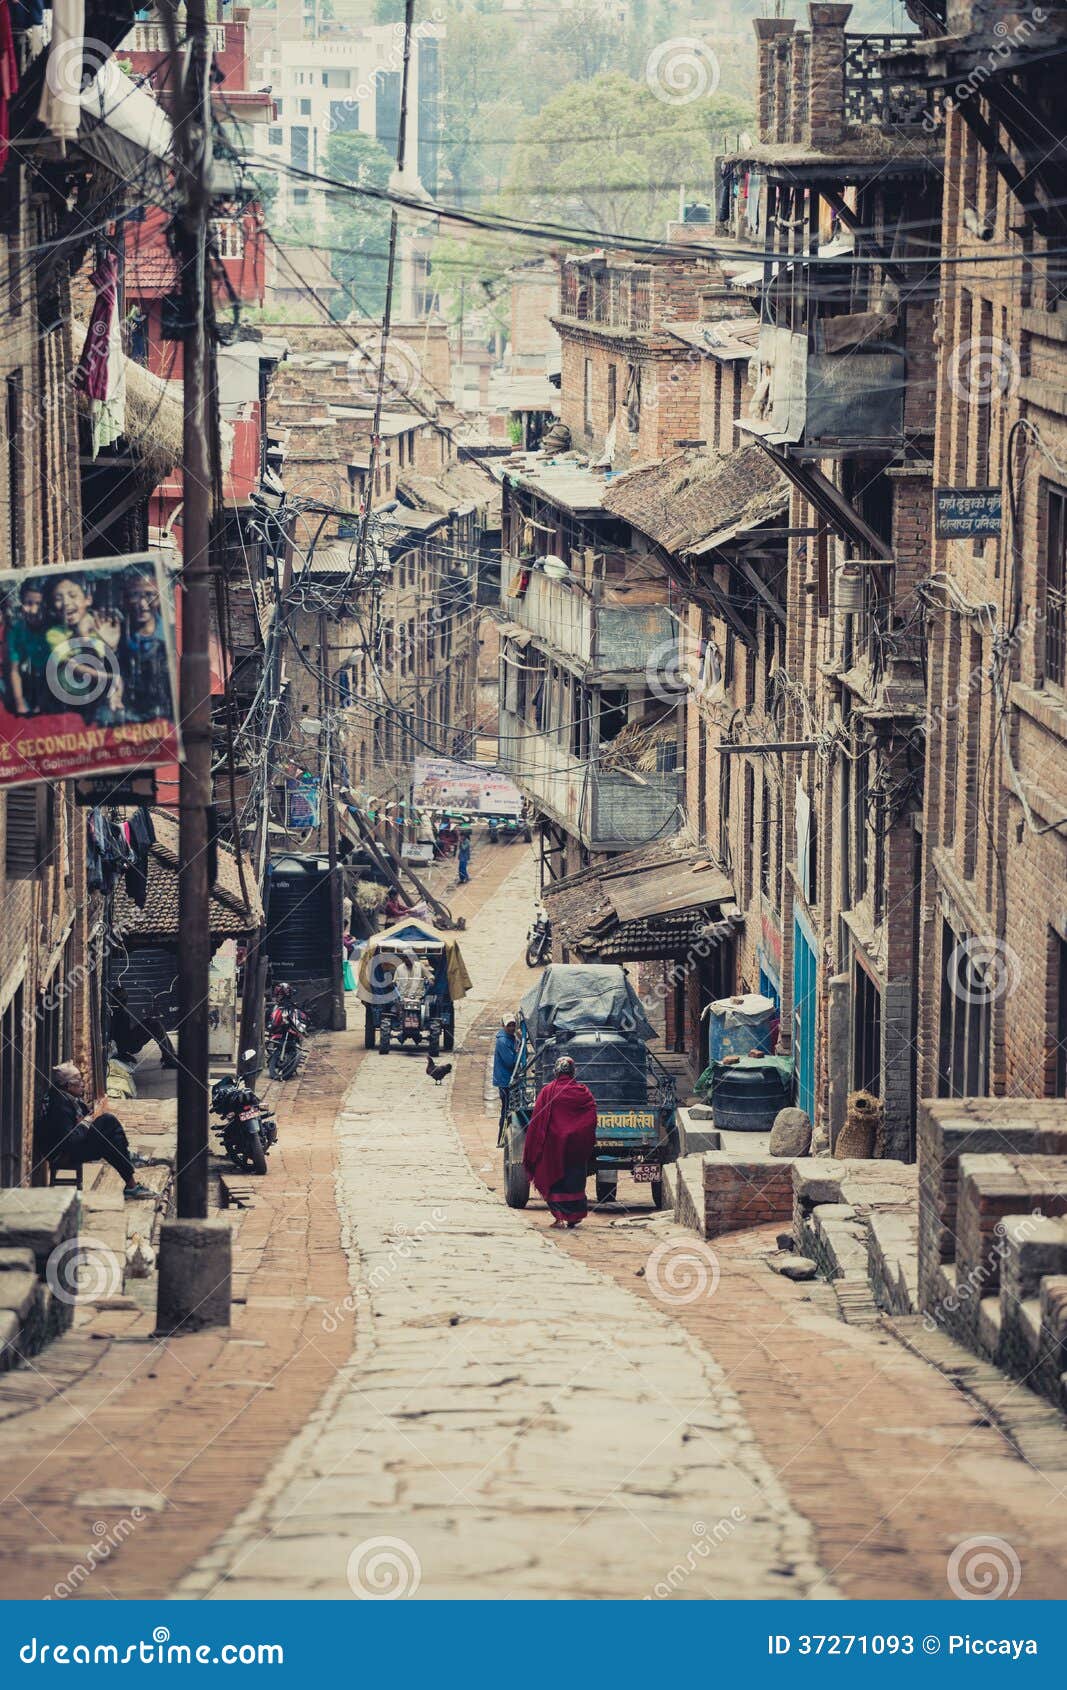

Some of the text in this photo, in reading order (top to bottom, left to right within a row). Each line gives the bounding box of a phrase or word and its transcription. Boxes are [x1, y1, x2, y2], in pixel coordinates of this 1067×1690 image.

[0, 720, 170, 761] E SECONDARY SCHOOL
